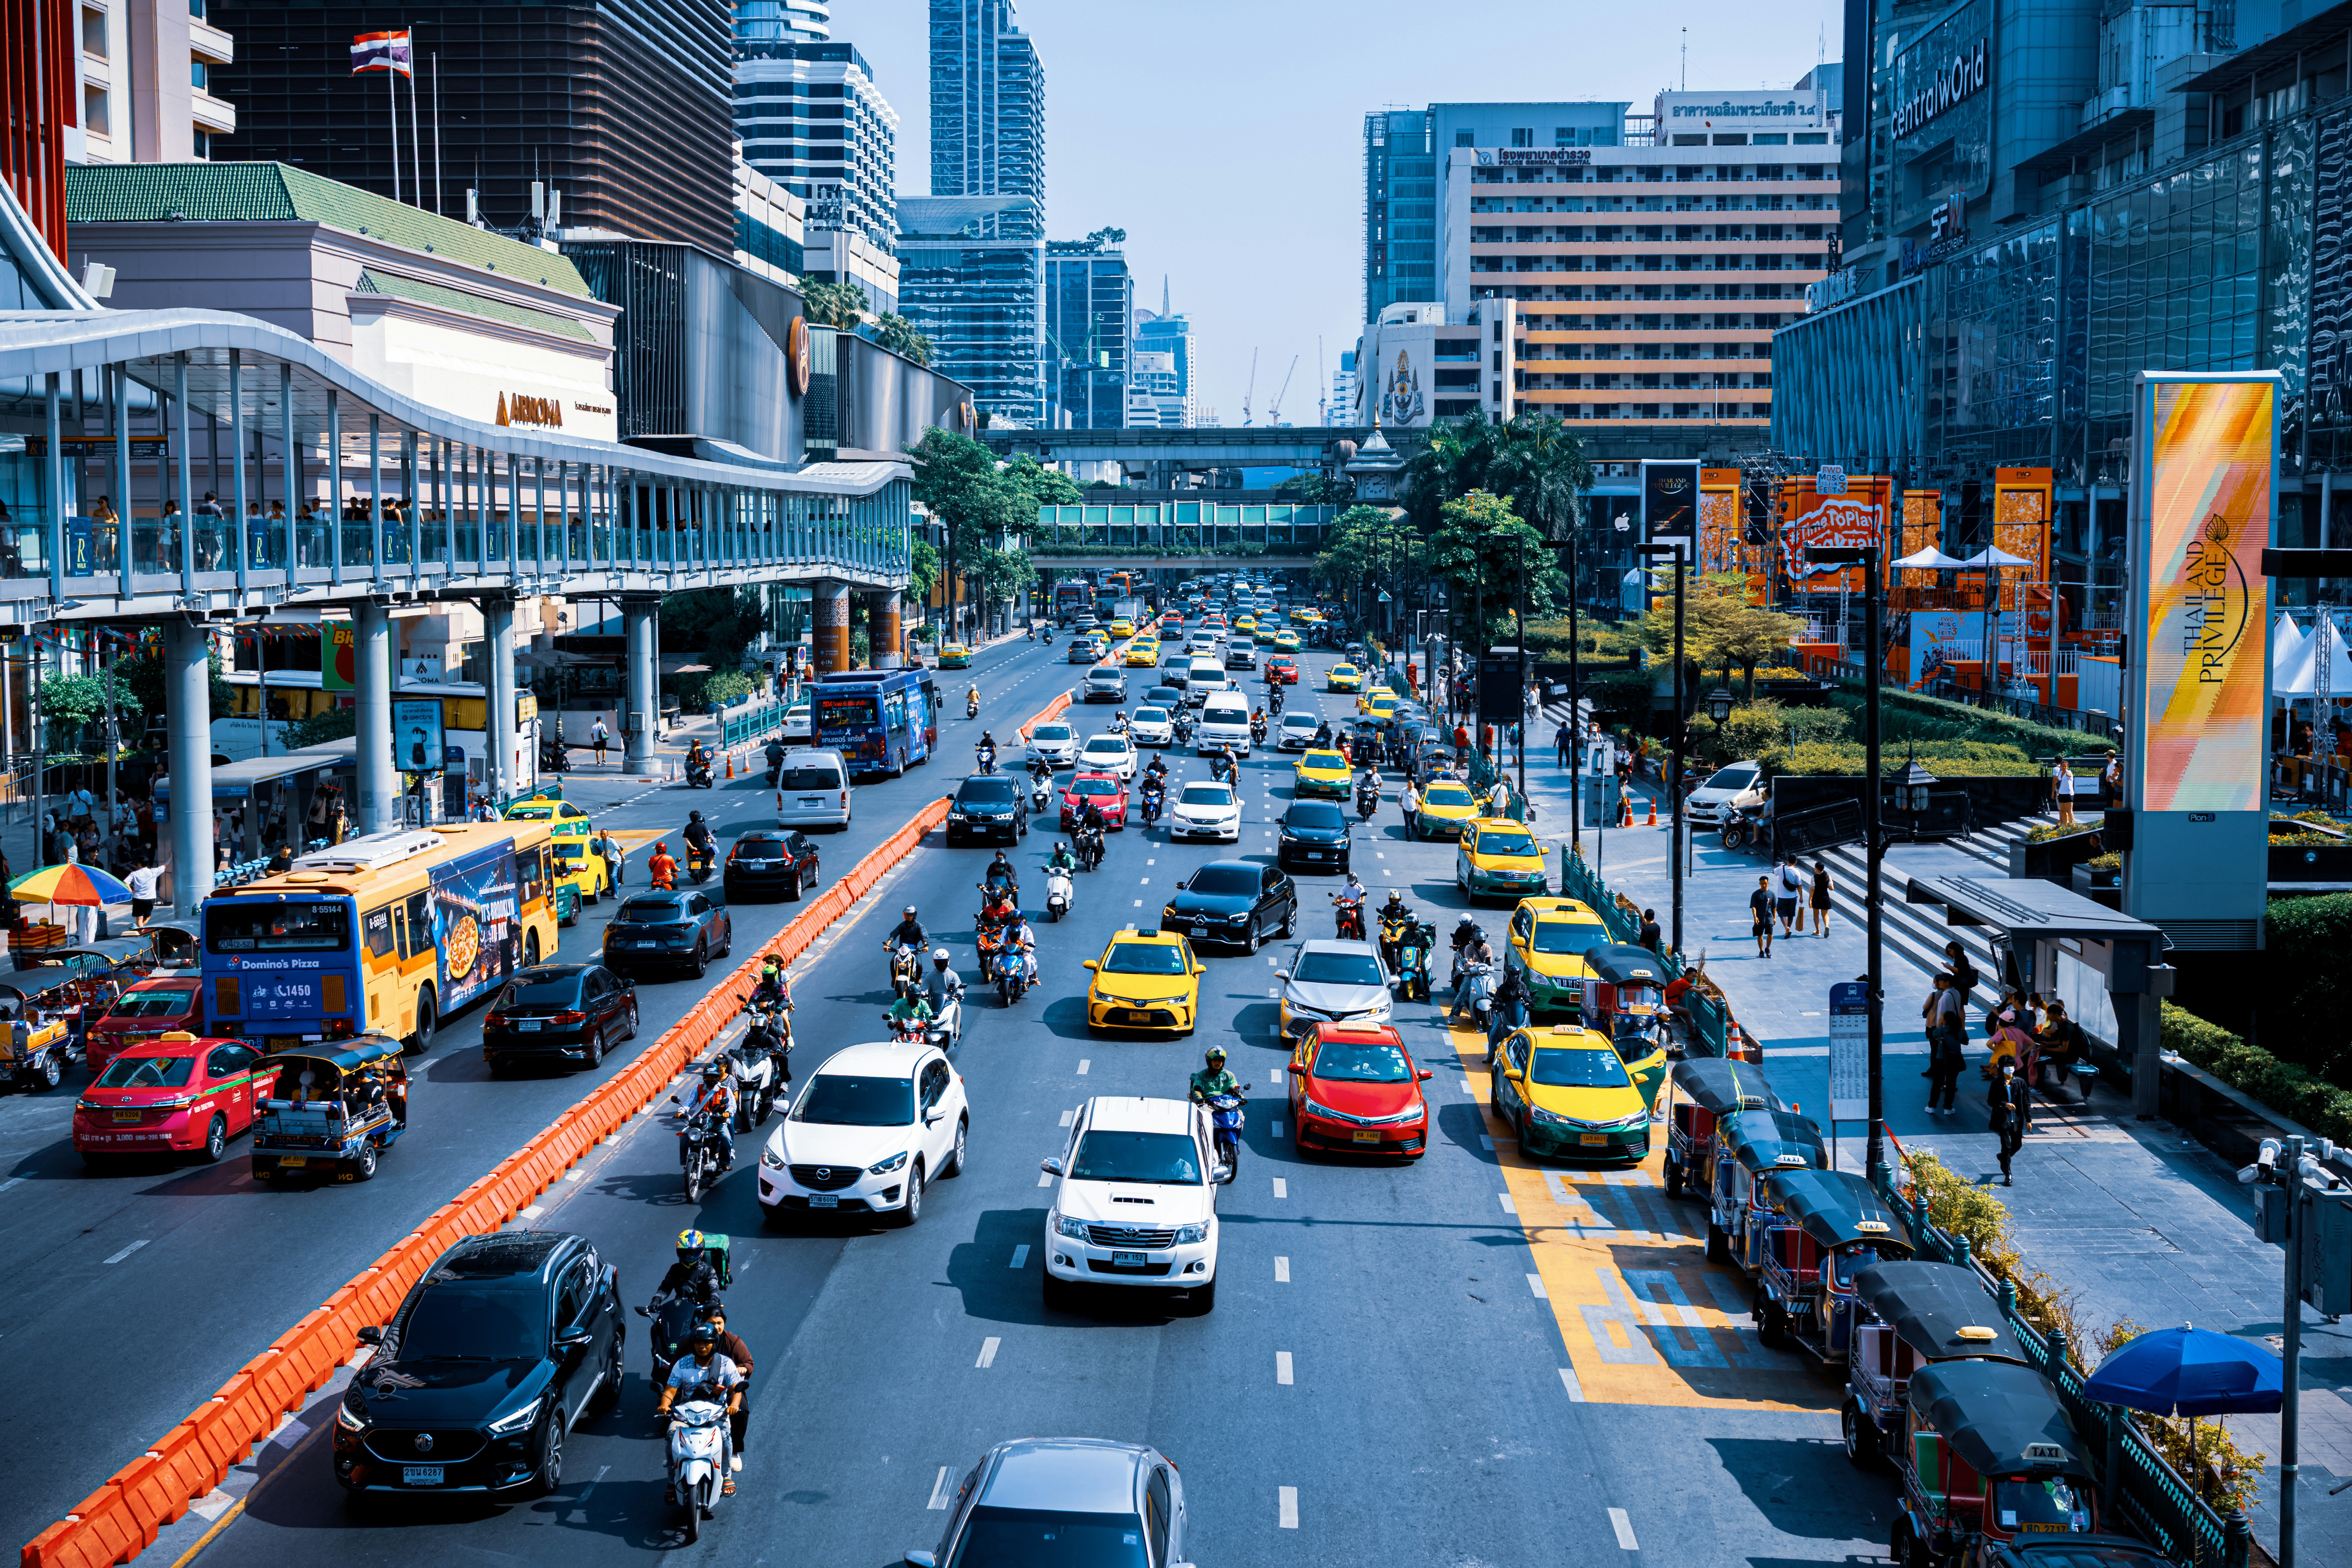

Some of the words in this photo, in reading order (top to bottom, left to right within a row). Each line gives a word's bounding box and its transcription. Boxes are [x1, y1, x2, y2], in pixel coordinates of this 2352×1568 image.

[1891, 37, 1987, 140] centralwOrld
[1672, 101, 1796, 117] อาคารเฉลิมพระเกียรติ
[1498, 147, 1591, 160] โรงพยาบาลตำรวจ
[1931, 242, 1946, 256] WORLD
[1947, 235, 1964, 250] CINEMA
[510, 392, 563, 427] ARNOMA
[77, 538, 85, 562] R
[256, 537, 262, 558] R
[388, 535, 392, 553] R
[2184, 540, 2205, 657] THAILAND
[2200, 552, 2227, 684] PRIVILEGE
[312, 905, 342, 914] 8-55144
[481, 903, 491, 923] IT'S
[490, 897, 515, 920] BROOKLYN
[369, 912, 387, 929] 8-55144
[498, 921, 508, 941] BKK
[242, 960, 289, 970] Domino's
[292, 958, 320, 969] Pizza
[286, 985, 311, 996] 1450
[2032, 1447, 2059, 1457] TAXI
[423, 1468, 442, 1476] 6287
